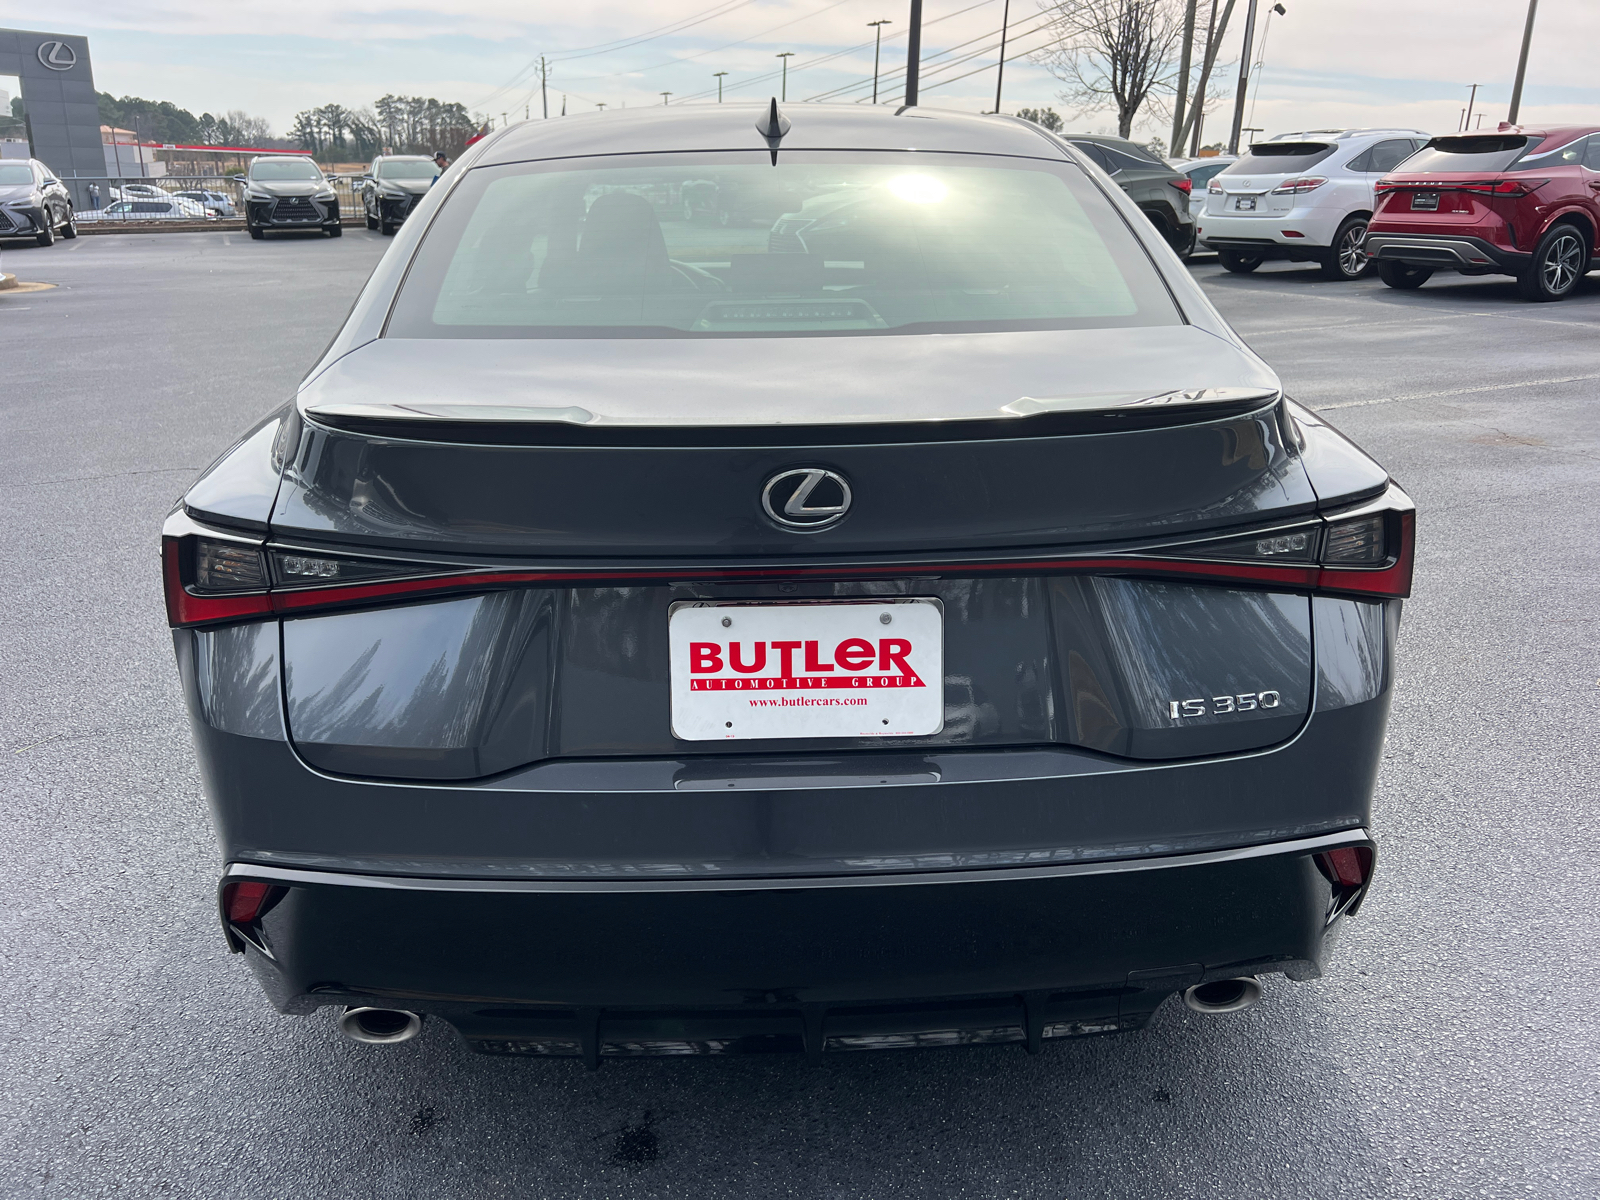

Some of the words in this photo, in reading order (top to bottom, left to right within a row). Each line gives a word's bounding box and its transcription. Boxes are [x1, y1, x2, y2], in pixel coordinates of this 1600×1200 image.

[691, 678, 828, 690] AUTOMOTIVE
[852, 676, 918, 687] GROUP
[749, 697, 868, 708] www.butlercars.com
[1169, 698, 1206, 720] IS
[1212, 690, 1281, 715] 350
